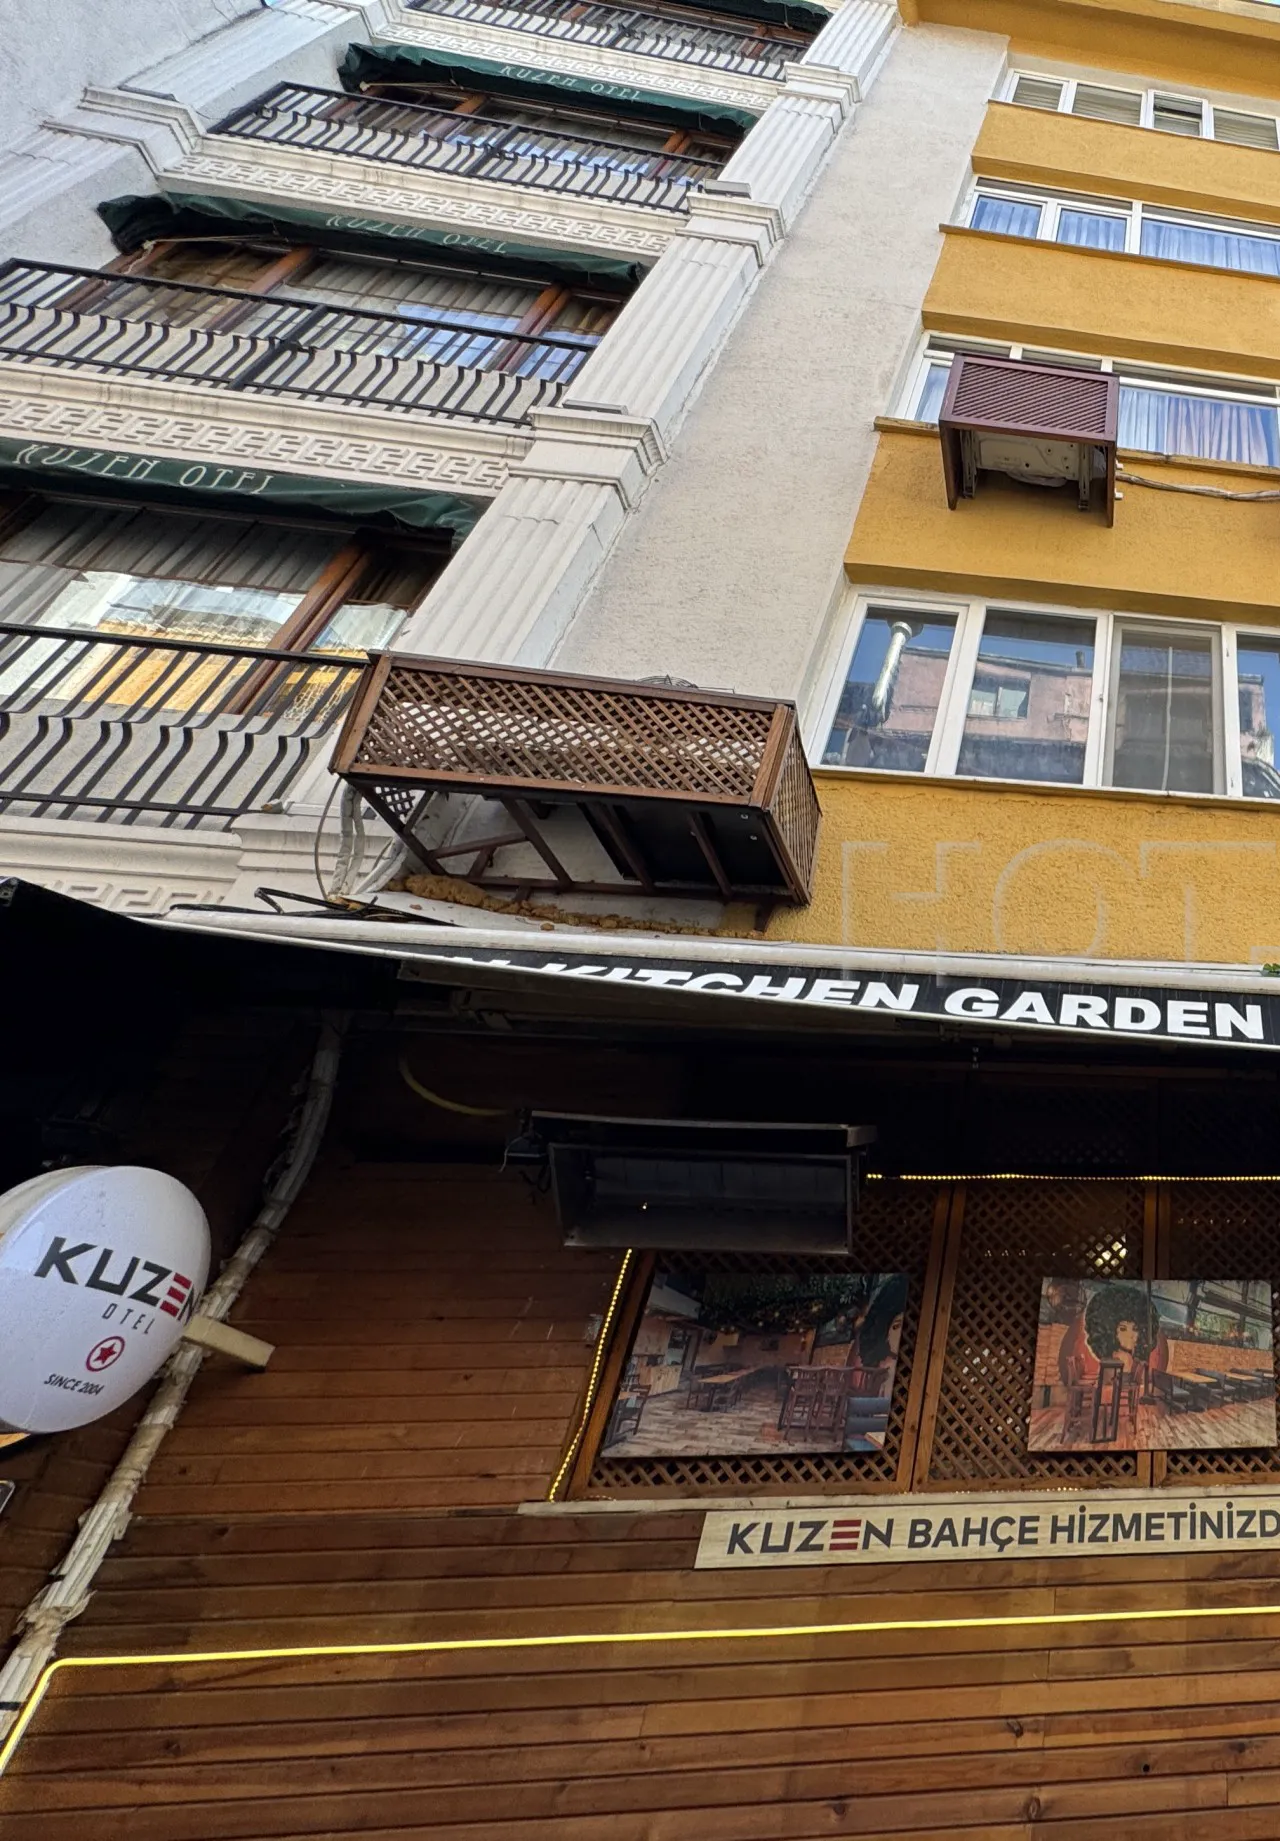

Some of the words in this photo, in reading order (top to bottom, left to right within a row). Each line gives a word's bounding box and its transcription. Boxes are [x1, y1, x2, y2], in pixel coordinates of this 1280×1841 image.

[944, 988, 1265, 1041] GARDEN
[102, 1302, 157, 1335] OTEL
[44, 1373, 79, 1392] SINCE
[78, 1379, 104, 1396] 2004
[726, 1517, 894, 1555] KUZEN
[906, 1515, 1039, 1554] BAHÇE
